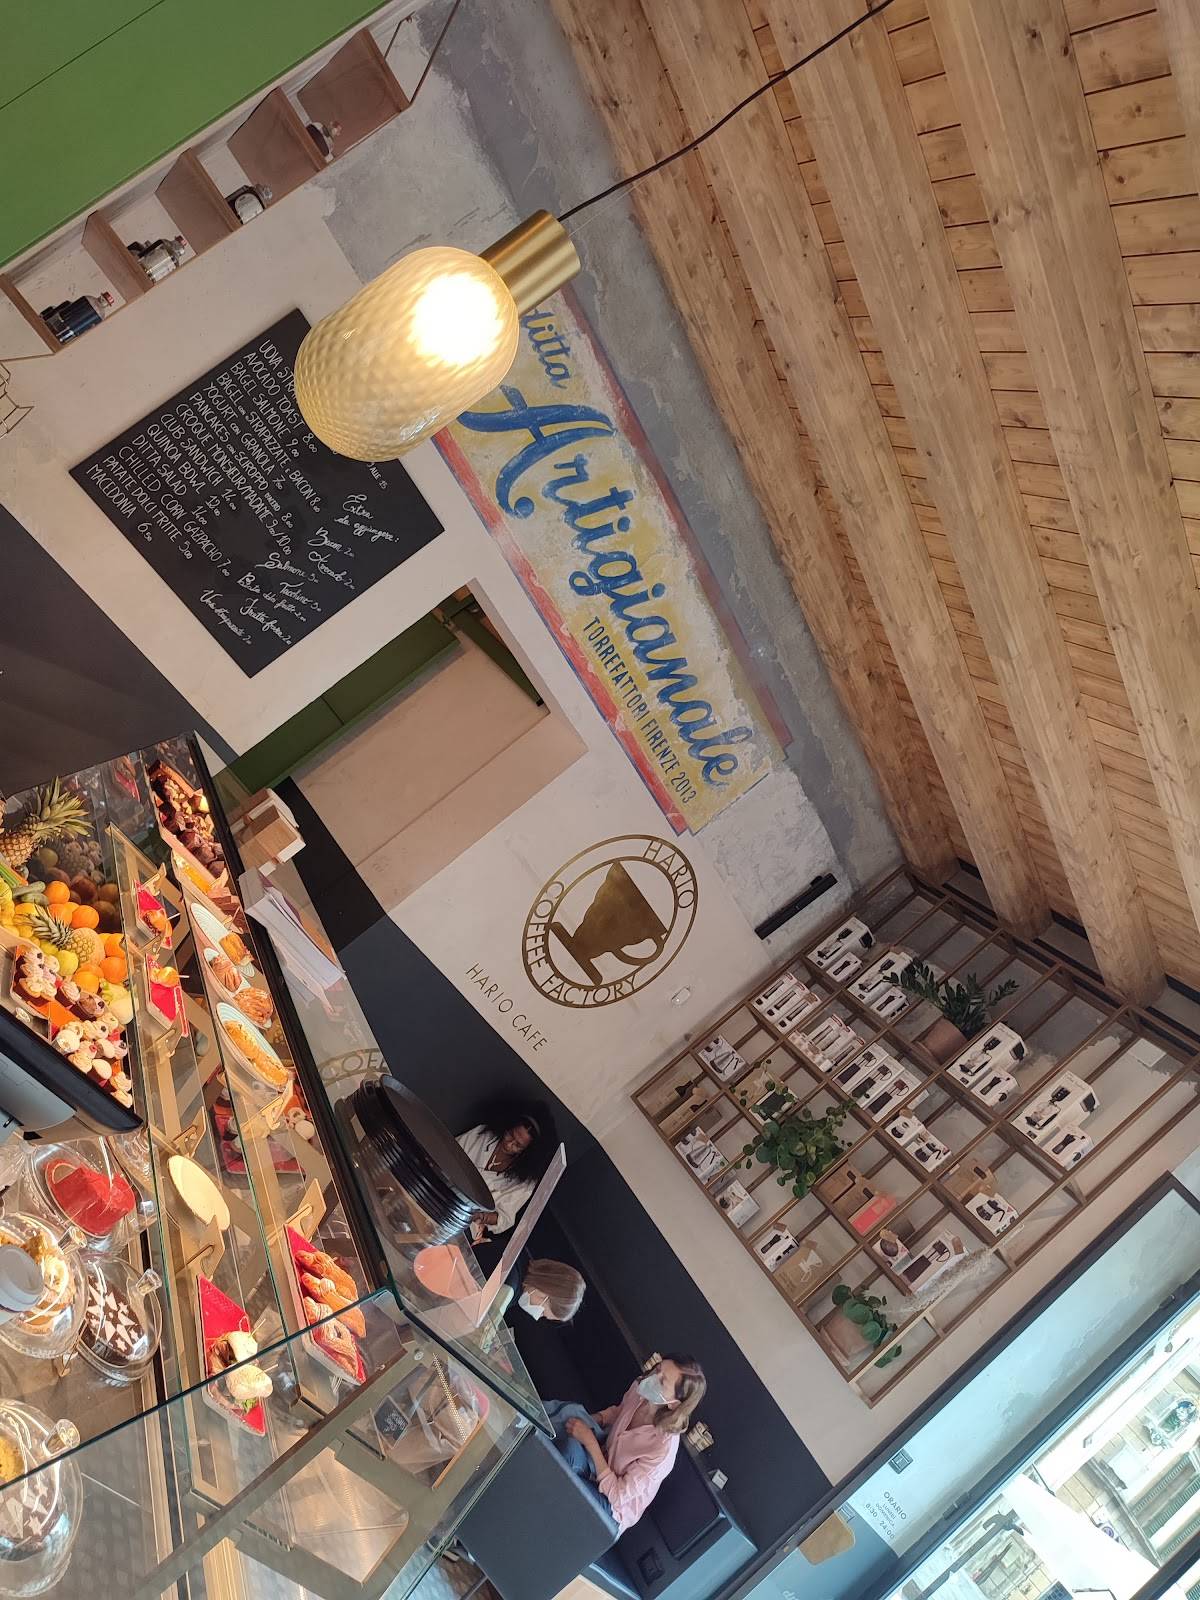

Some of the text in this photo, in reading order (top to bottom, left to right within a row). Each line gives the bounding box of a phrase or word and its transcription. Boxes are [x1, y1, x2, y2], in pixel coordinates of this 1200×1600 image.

[242, 351, 280, 395] AVOCADO
[275, 393, 305, 429] TOAST
[258, 339, 283, 370] UOVA
[175, 403, 214, 447] CROQUE
[202, 381, 238, 422] YOGURT
[240, 432, 275, 475] GRANOLA
[215, 371, 244, 407] BAGEL
[244, 410, 291, 468] STRAPAZZATE
[288, 469, 316, 500] BACON
[229, 360, 257, 396] BAGEL
[251, 392, 291, 439] SALMONE
[131, 433, 161, 467] DITTA
[156, 463, 187, 495] SALAD
[146, 423, 182, 464] QUINOA
[177, 460, 206, 494] BOWL
[160, 413, 185, 439] CLUB
[179, 437, 224, 486] SANDWICH
[188, 391, 230, 442] PANCAKES
[233, 450, 268, 490] SCIROPPO
[85, 463, 136, 518] MACEDONIA
[102, 455, 137, 491] PATATE
[130, 486, 157, 513] DOLCI
[151, 509, 182, 542] FRITTE
[118, 445, 161, 491] CHILLED
[160, 493, 187, 520] CORN
[183, 520, 222, 561] GAZPACHO
[342, 493, 373, 519] Extra
[456, 385, 754, 789] Artigianale
[582, 616, 697, 804] TORREFATTORI FIRENZE 2013
[643, 839, 694, 909] HARIO
[528, 882, 636, 1007] COFFEE FACTORY
[465, 962, 547, 1052] HARIO CAFE
[884, 1491, 906, 1519] ORARIO
